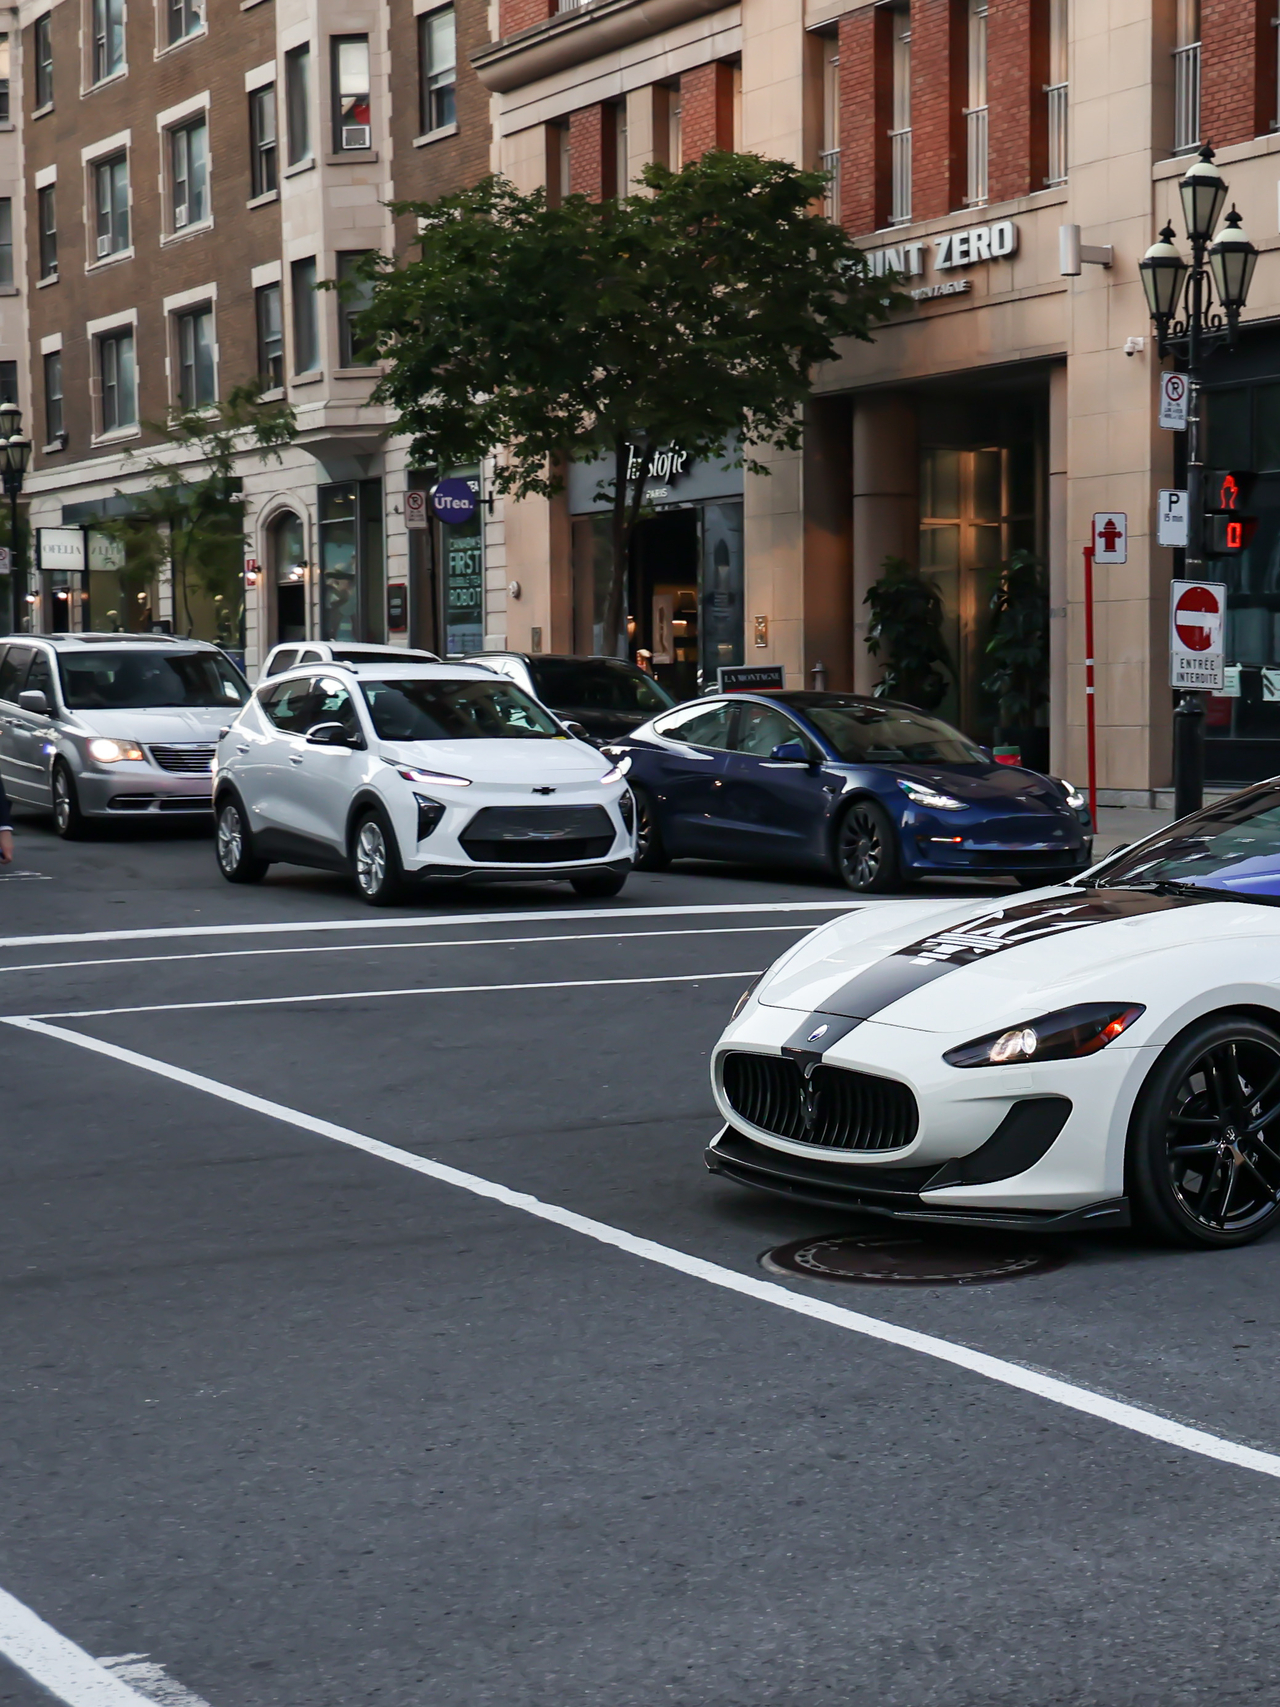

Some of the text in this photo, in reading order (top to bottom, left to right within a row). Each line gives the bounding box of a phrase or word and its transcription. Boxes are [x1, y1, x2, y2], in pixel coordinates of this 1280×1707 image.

[934, 220, 1015, 271] ZERO
[1168, 493, 1180, 513] P
[1172, 514, 1184, 523] min
[1227, 522, 1242, 547] 0
[449, 550, 482, 575] FIRST
[449, 588, 482, 606] ROBOT
[1180, 657, 1215, 671] ENTRÉE
[724, 672, 780, 683] LA MONTAGNE
[1176, 672, 1219, 685] INTERDITE
